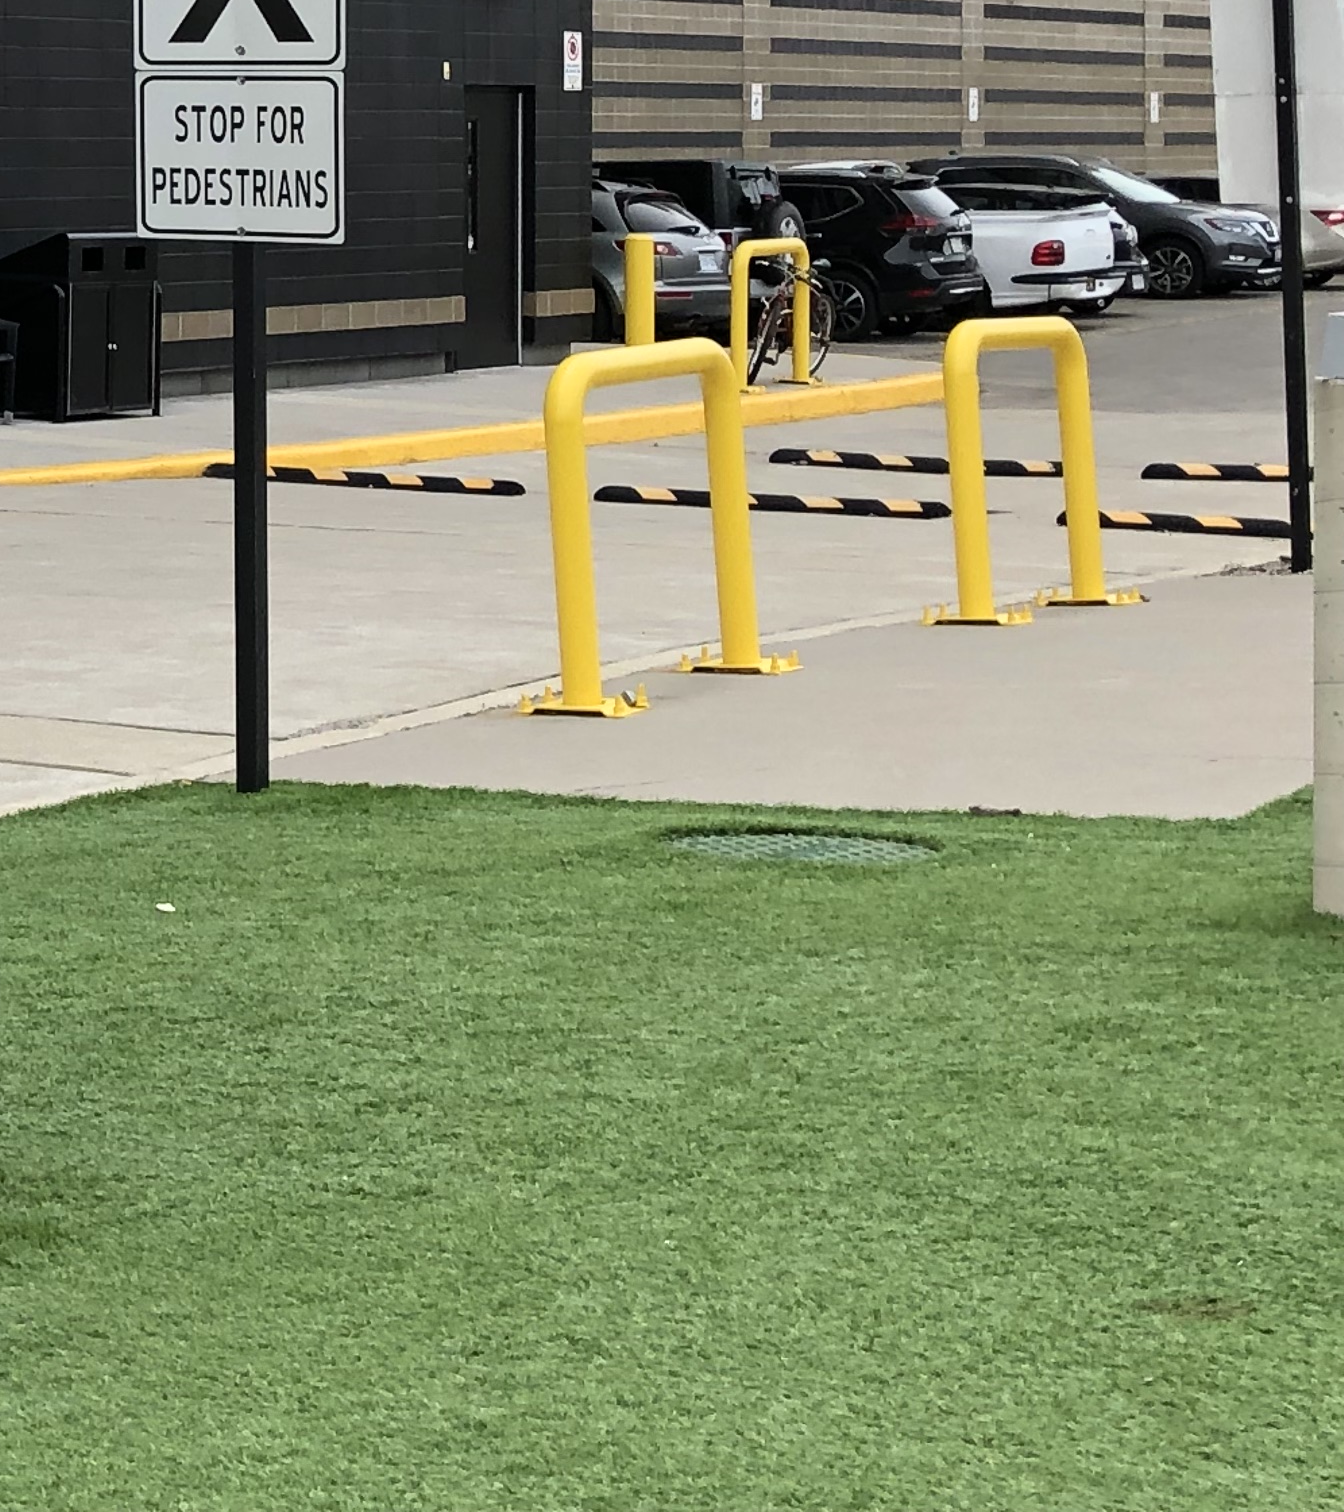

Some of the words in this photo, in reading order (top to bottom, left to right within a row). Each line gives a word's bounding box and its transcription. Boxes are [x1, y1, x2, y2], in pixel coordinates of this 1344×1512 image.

[174, 104, 245, 144] STOP
[256, 105, 305, 145] FOR
[151, 167, 330, 209] PEDESTRIANS
